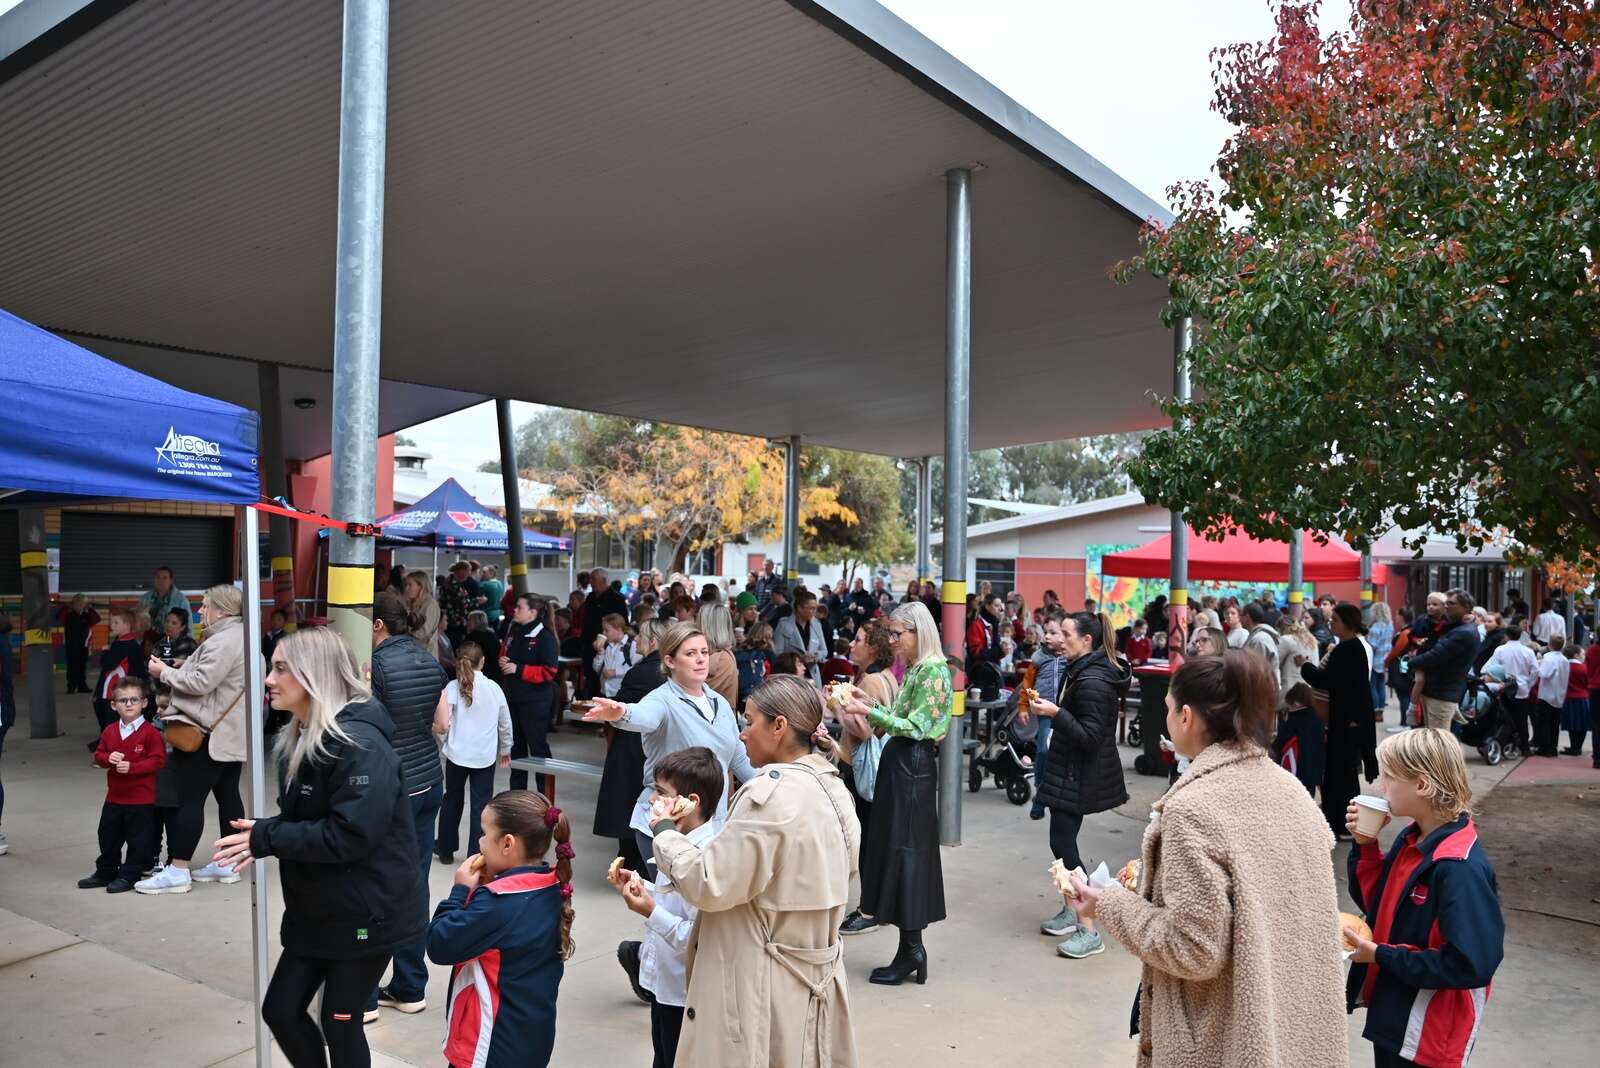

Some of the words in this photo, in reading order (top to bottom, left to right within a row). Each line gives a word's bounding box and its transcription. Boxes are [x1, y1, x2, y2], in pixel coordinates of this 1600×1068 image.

[154, 425, 222, 467] Allegra
[174, 453, 220, 464] allegra.com.au
[462, 539, 488, 547] MOAMA
[349, 775, 369, 785] FXD
